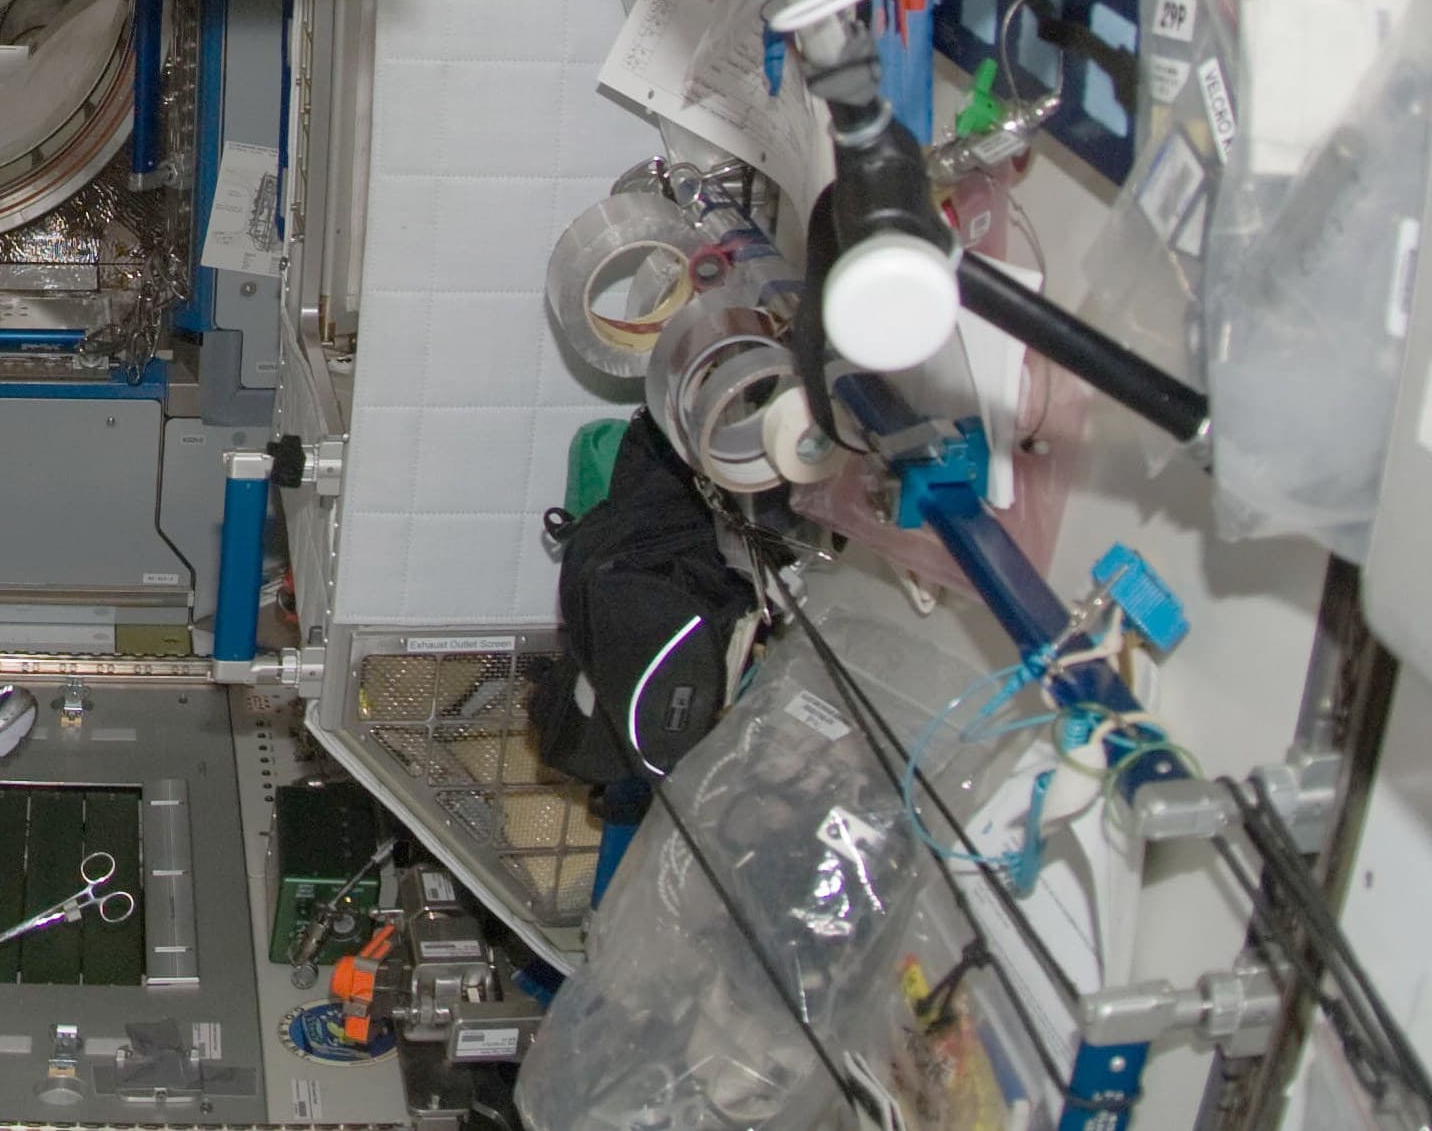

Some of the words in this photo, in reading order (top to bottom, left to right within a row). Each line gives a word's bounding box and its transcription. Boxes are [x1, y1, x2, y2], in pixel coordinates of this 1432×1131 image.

[1204, 70, 1233, 135] VELCRO
[409, 640, 448, 650] Exhaust
[449, 639, 478, 649] Outlet
[479, 639, 513, 648] Screen
